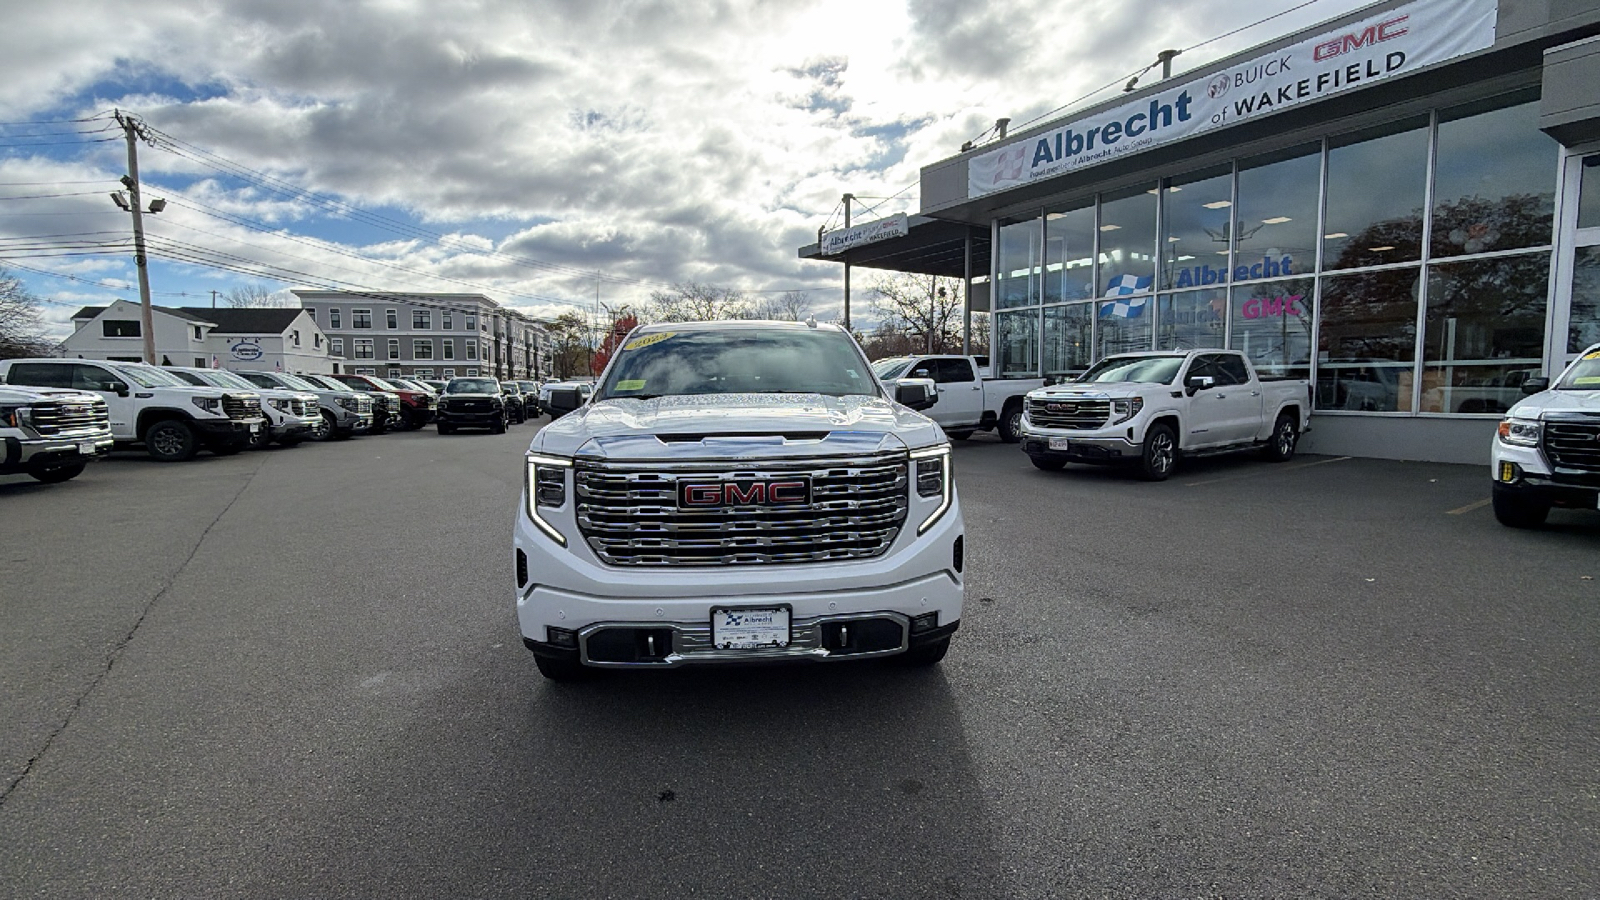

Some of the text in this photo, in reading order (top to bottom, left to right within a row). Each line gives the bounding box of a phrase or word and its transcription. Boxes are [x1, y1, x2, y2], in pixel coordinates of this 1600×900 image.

[1234, 14, 1409, 88] BUICK GMC
[1211, 51, 1406, 124] of WAKEFIELD
[1031, 88, 1192, 169] Albrecht
[1078, 148, 1111, 164] Albrecht
[830, 231, 862, 246] Albrecht
[1176, 255, 1293, 288] Albrecht
[1242, 294, 1301, 320] GMC
[685, 481, 805, 506] GMC
